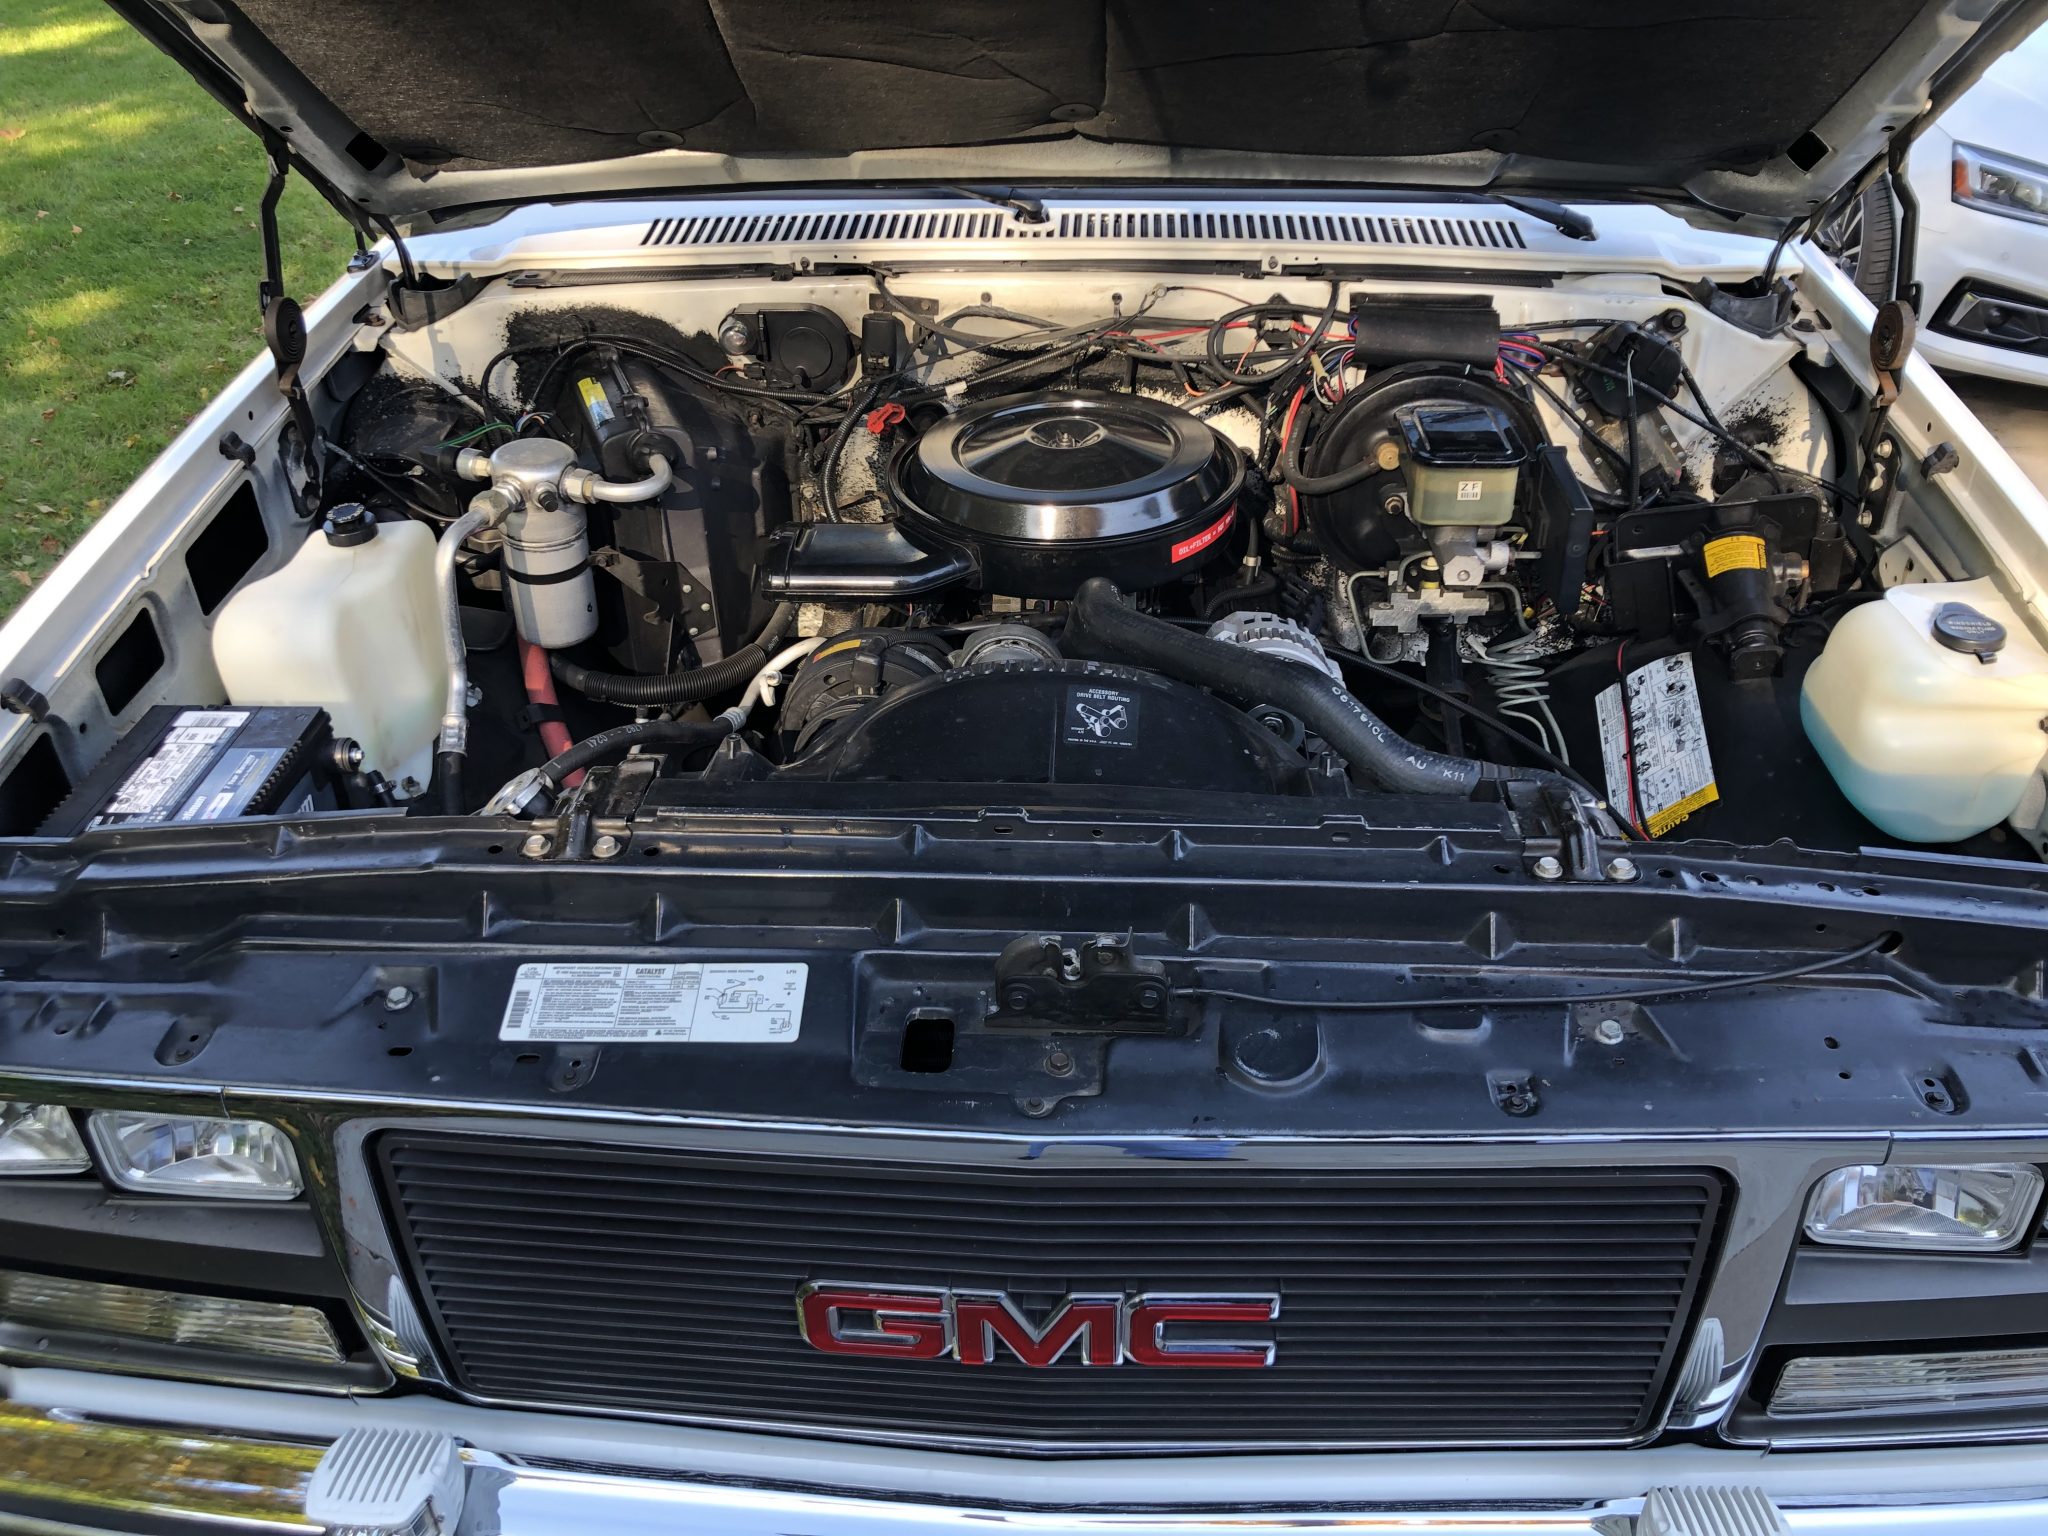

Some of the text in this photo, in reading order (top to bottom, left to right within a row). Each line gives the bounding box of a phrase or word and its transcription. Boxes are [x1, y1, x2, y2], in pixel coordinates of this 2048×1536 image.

[1088, 688, 1119, 696] ACCESSORY
[1107, 695, 1131, 703] ROUTING
[1651, 813, 1690, 839] CAUTIO
[796, 1279, 1281, 1367] GMC
